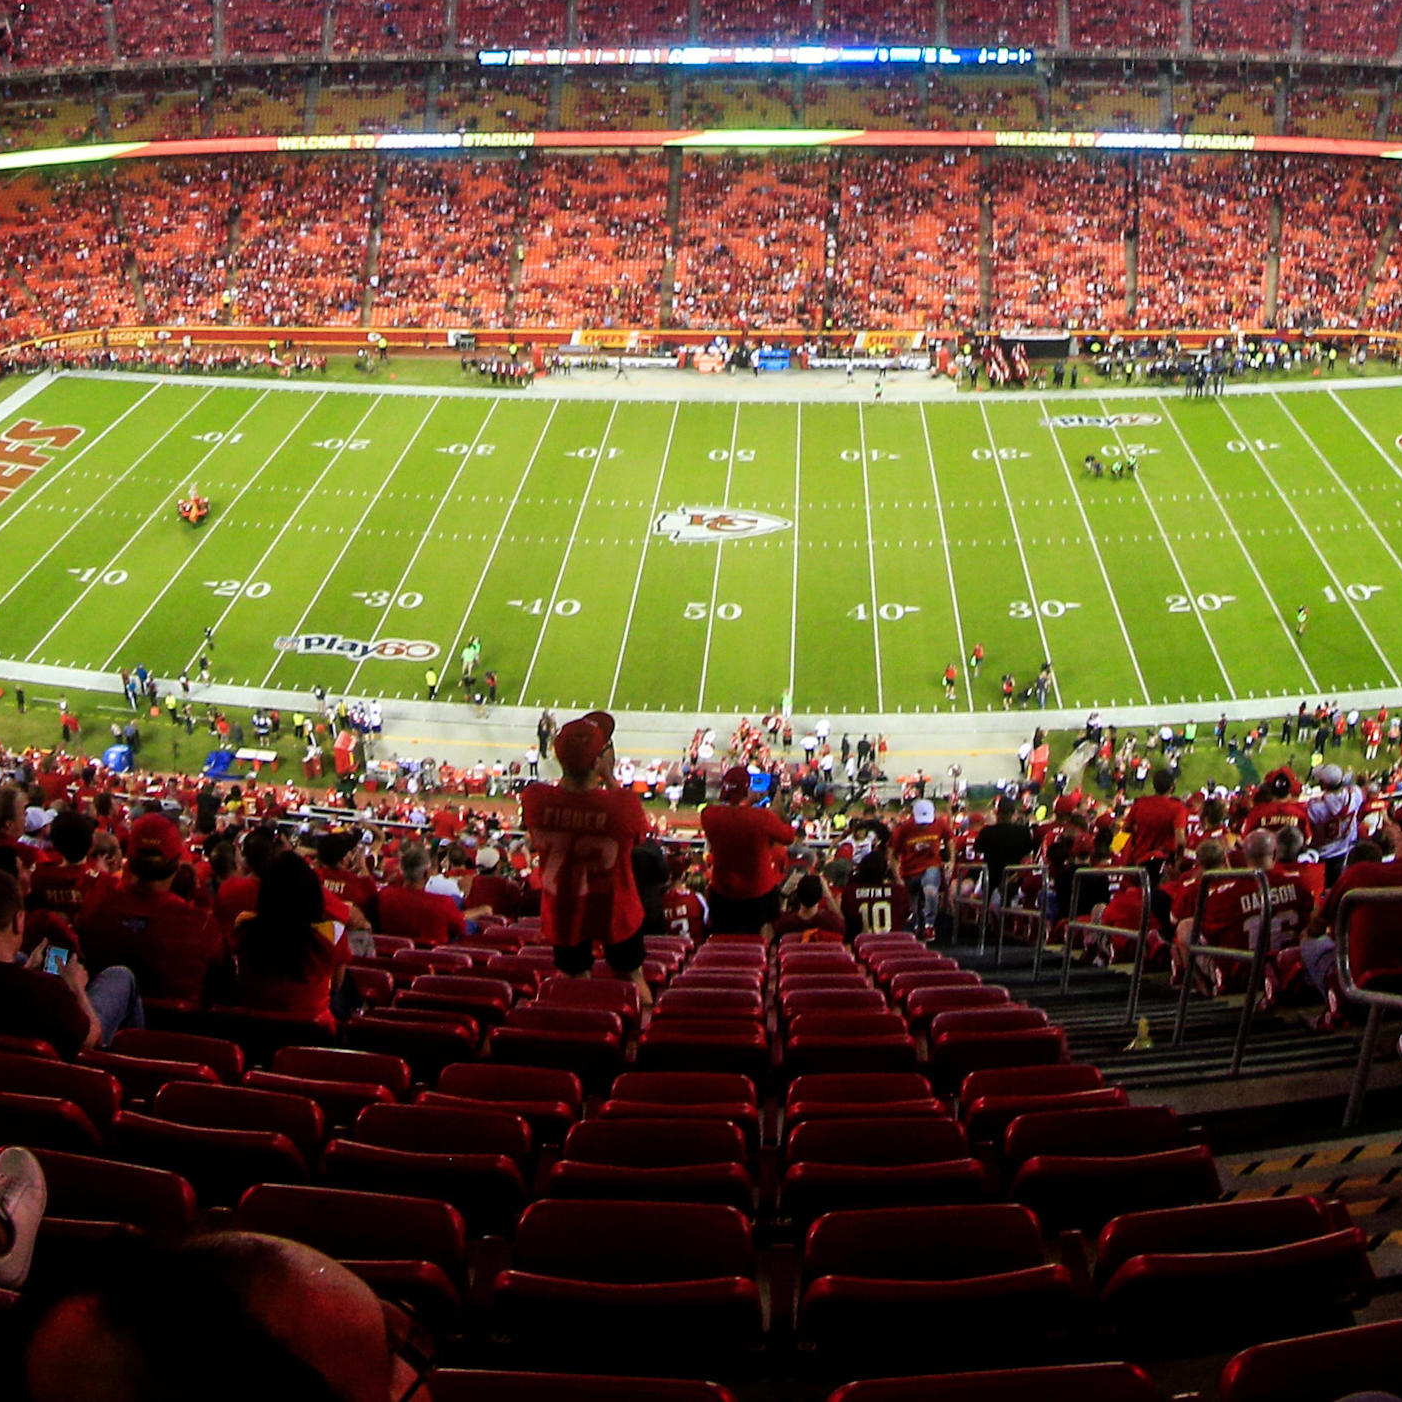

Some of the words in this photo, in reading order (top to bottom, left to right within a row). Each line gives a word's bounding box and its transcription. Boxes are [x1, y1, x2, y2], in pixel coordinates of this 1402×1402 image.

[277, 135, 352, 149] WELCOME
[355, 135, 375, 148] TO
[462, 133, 535, 147] STADIUM
[995, 132, 1071, 146] WELCOME
[1074, 132, 1094, 147] TO
[1183, 134, 1255, 149] STADIUM
[542, 807, 607, 830] FISHER
[1239, 883, 1298, 914] DASON
[858, 900, 892, 935] 10
